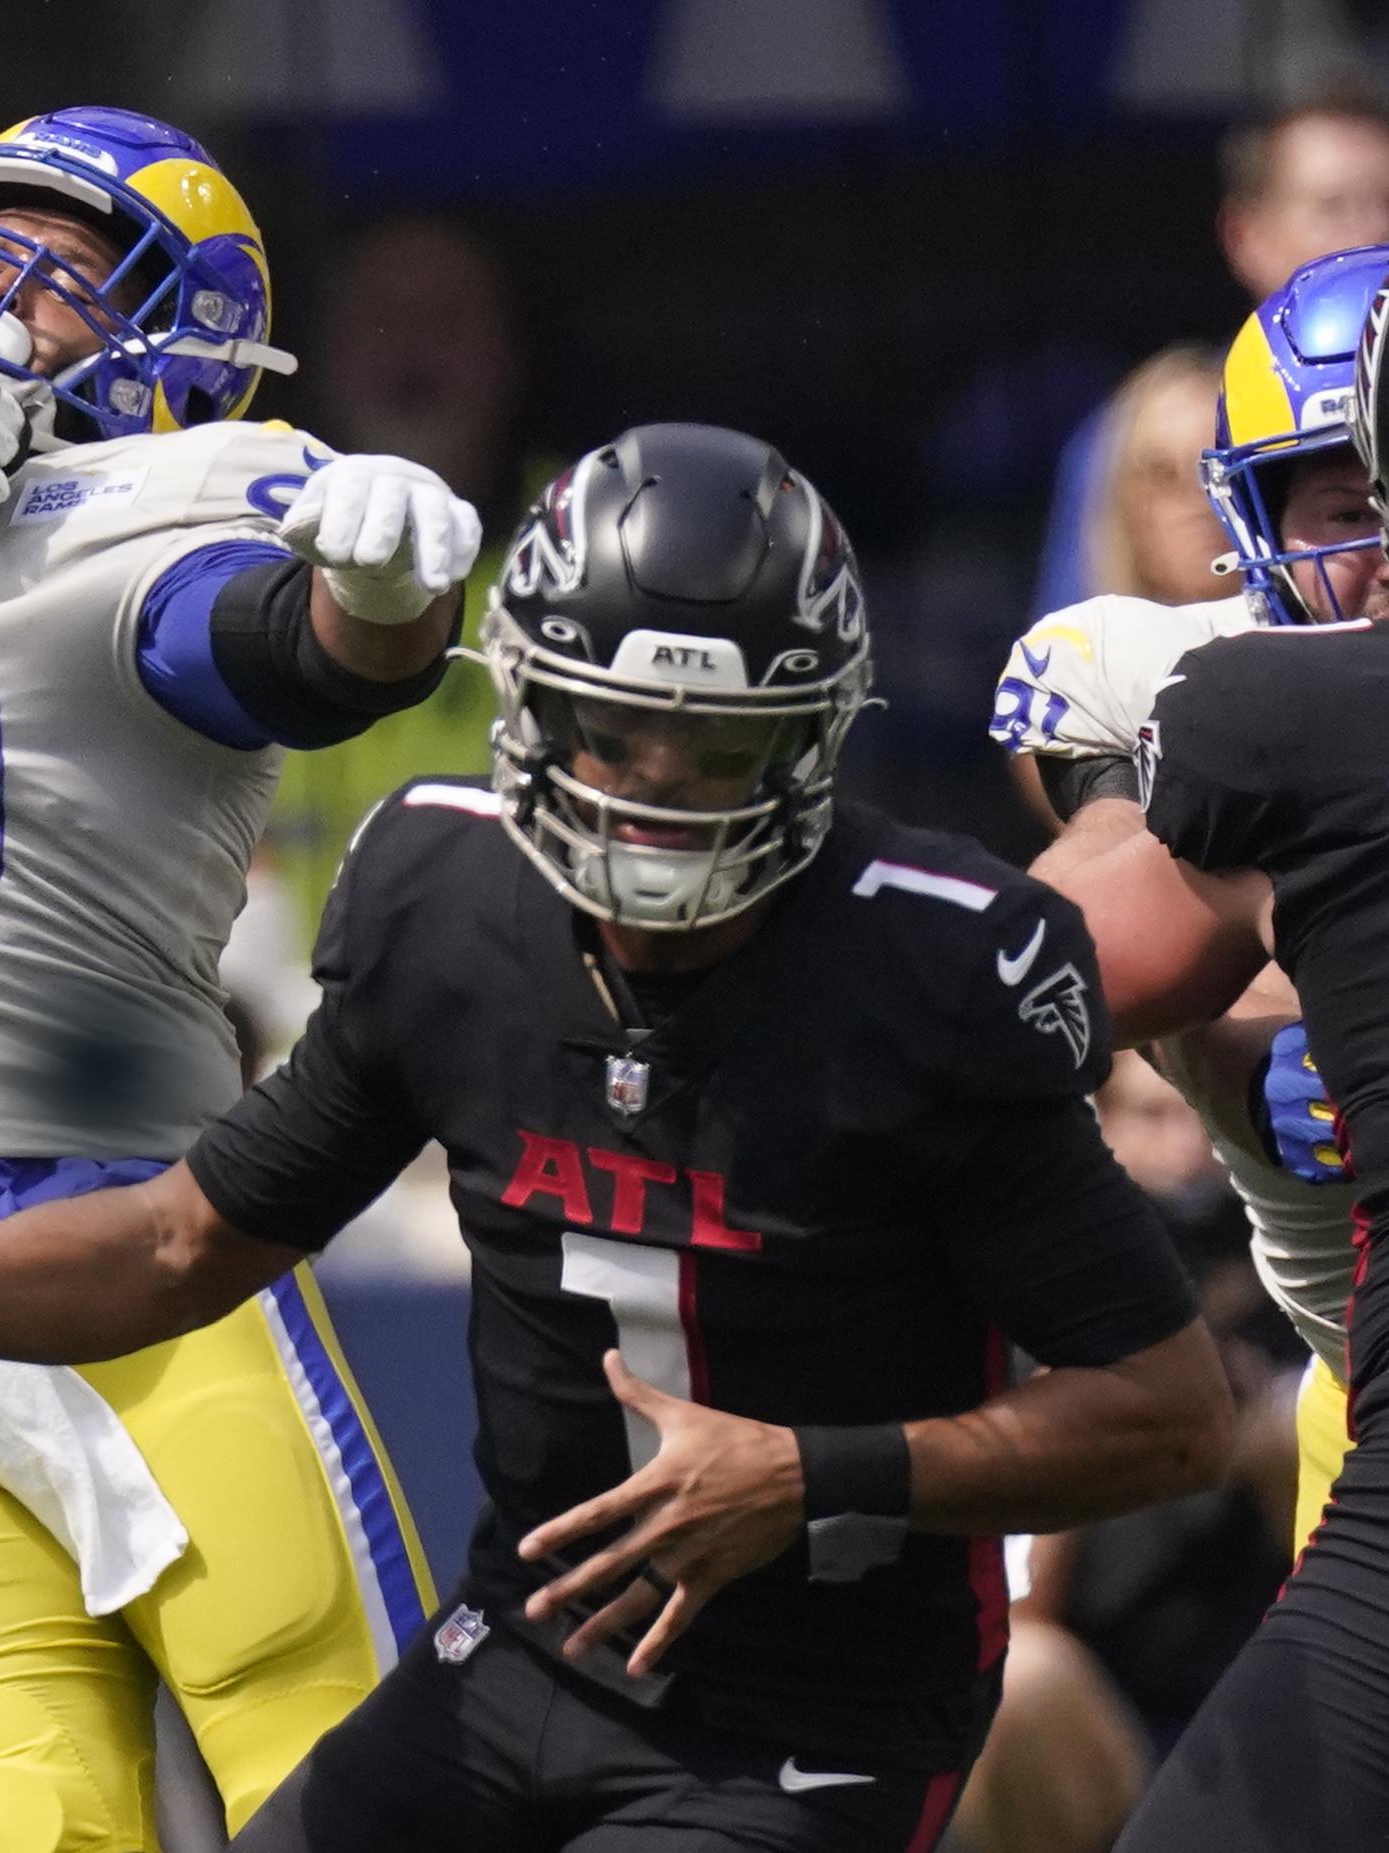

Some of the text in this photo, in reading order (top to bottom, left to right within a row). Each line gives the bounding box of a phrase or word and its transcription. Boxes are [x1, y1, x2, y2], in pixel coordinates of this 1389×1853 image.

[25, 483, 134, 506] ANGELES
[32, 480, 79, 496] LOS
[22, 499, 88, 516] RAMS
[651, 645, 716, 671] ATL
[850, 859, 1000, 913] 1
[500, 1128, 763, 1252] ATL
[560, 1231, 708, 1478] 1
